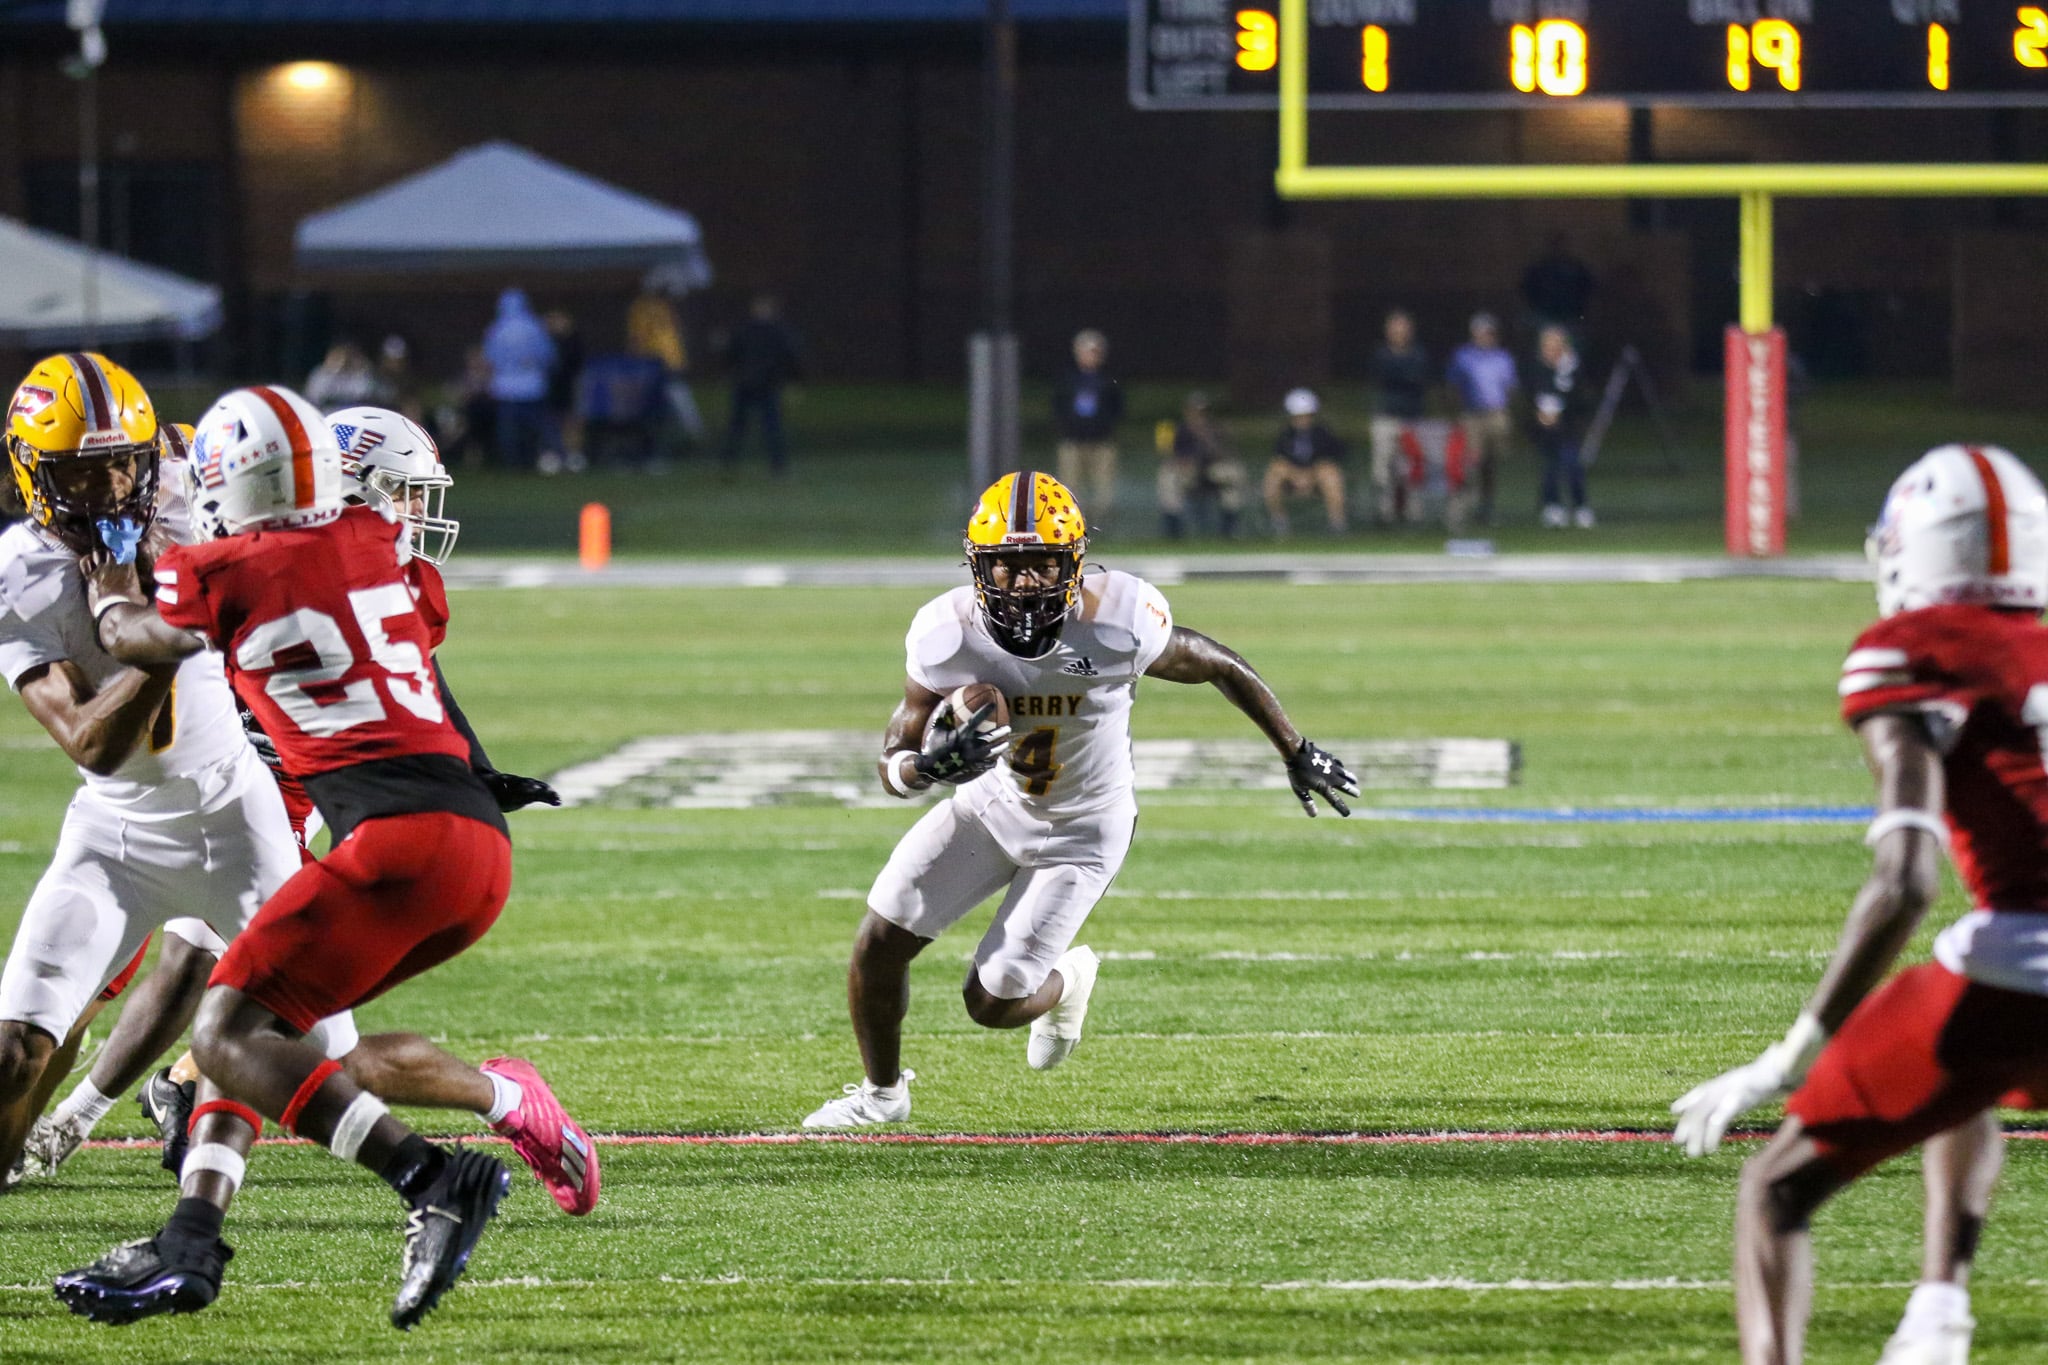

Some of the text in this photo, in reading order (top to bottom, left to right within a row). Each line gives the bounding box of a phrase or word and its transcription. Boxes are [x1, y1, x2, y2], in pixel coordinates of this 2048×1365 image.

[1236, 10, 1277, 71] 3
[1362, 24, 1388, 92] 1
[1510, 18, 1587, 96] 10
[1727, 18, 1800, 92] 19
[1927, 23, 1949, 91] 1
[2013, 6, 2048, 68] 2
[87, 433, 125, 445] Riddell
[265, 440, 279, 454] 25
[1006, 535, 1037, 543] Riddell
[237, 583, 443, 738] 25
[1006, 695, 1082, 717] ERRY
[1009, 725, 1064, 797] 4
